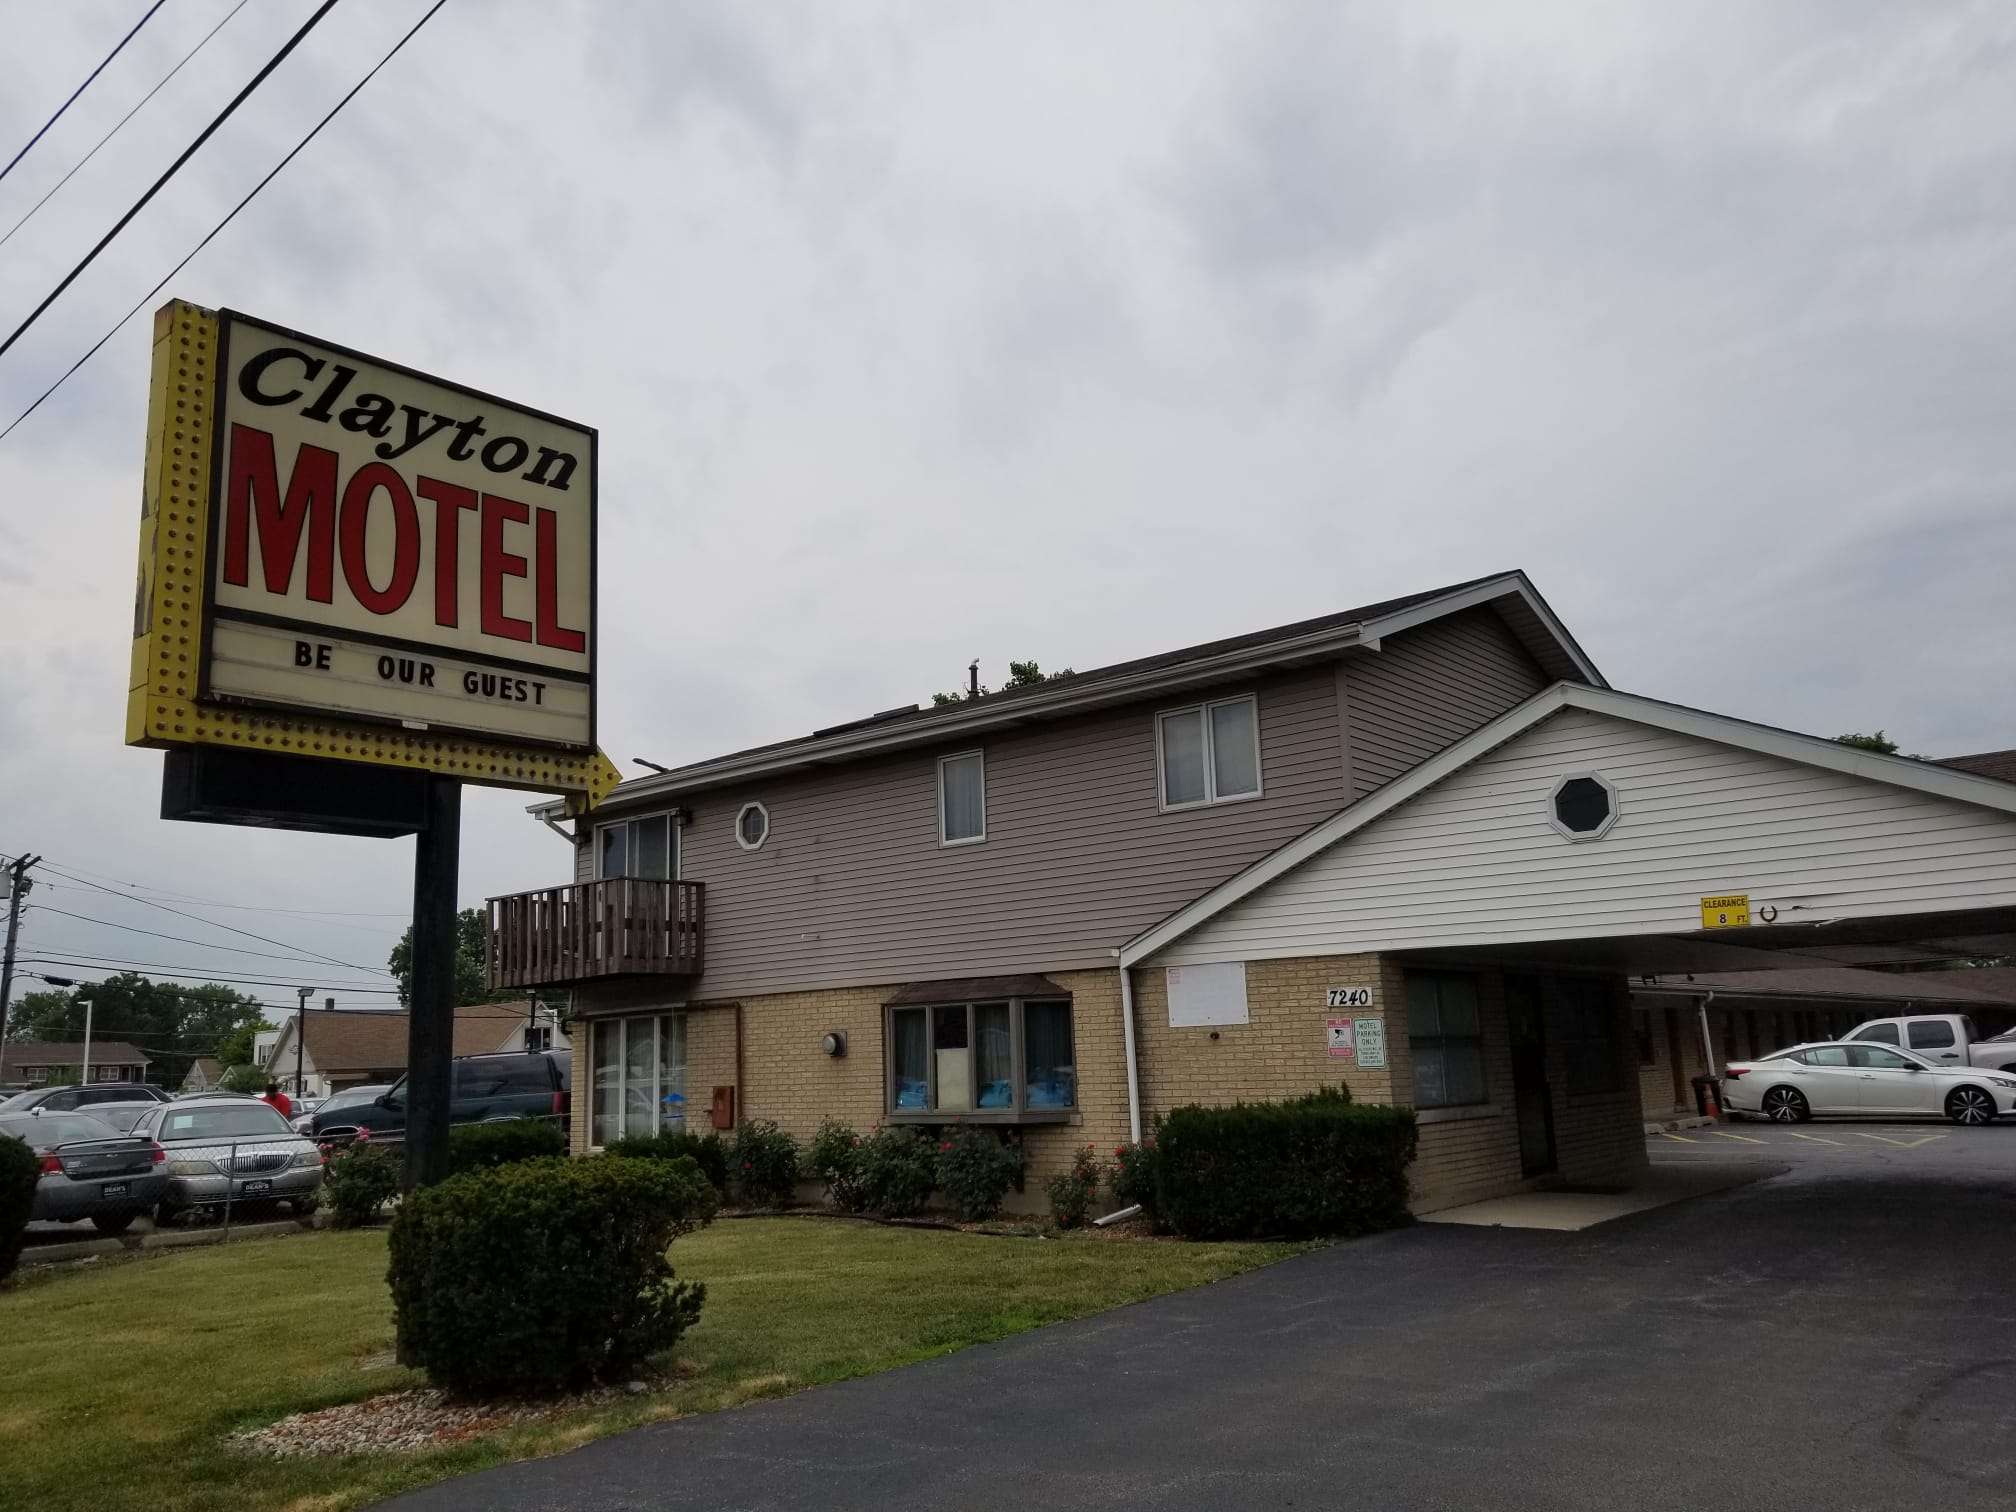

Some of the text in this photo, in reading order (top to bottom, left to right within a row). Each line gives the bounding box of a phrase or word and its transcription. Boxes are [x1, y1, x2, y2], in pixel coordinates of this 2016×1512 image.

[238, 347, 578, 491] Clayton
[223, 421, 586, 653] MOTEL
[294, 640, 546, 705] BE OUR GUEST
[1703, 898, 1746, 909] CLEARANCE
[1719, 914, 1727, 924] 8
[1329, 990, 1368, 1006] 7240
[1361, 1038, 1377, 1046] ONLY
